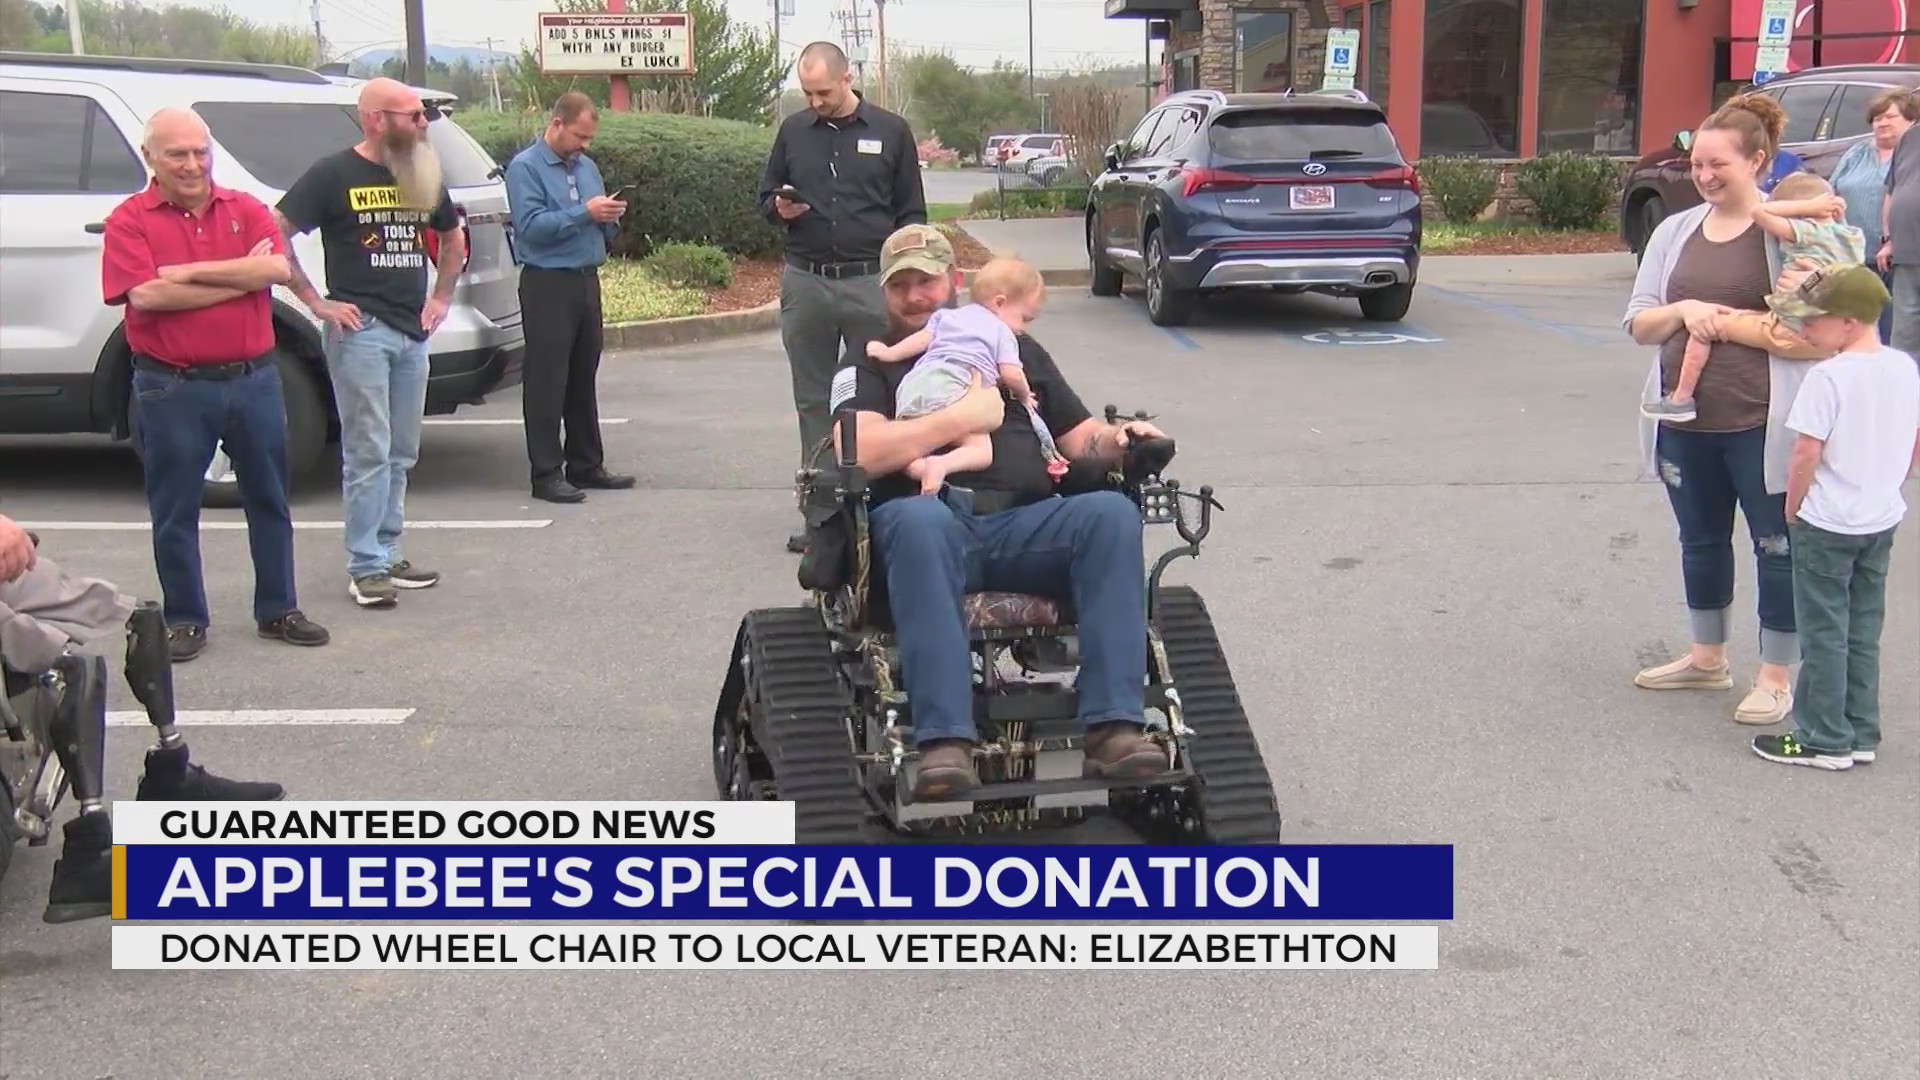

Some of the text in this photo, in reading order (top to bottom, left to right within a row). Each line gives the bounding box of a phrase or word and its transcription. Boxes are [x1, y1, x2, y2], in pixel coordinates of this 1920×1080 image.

[549, 28, 672, 40] ADD 5 BNLS WINGS $1
[562, 42, 665, 53] WITH ANY BURGER
[621, 55, 680, 67] EX LUNCH
[358, 212, 372, 224] DO
[374, 211, 392, 222] NOT
[383, 225, 416, 239] TOOLS
[386, 241, 414, 252] OR MY
